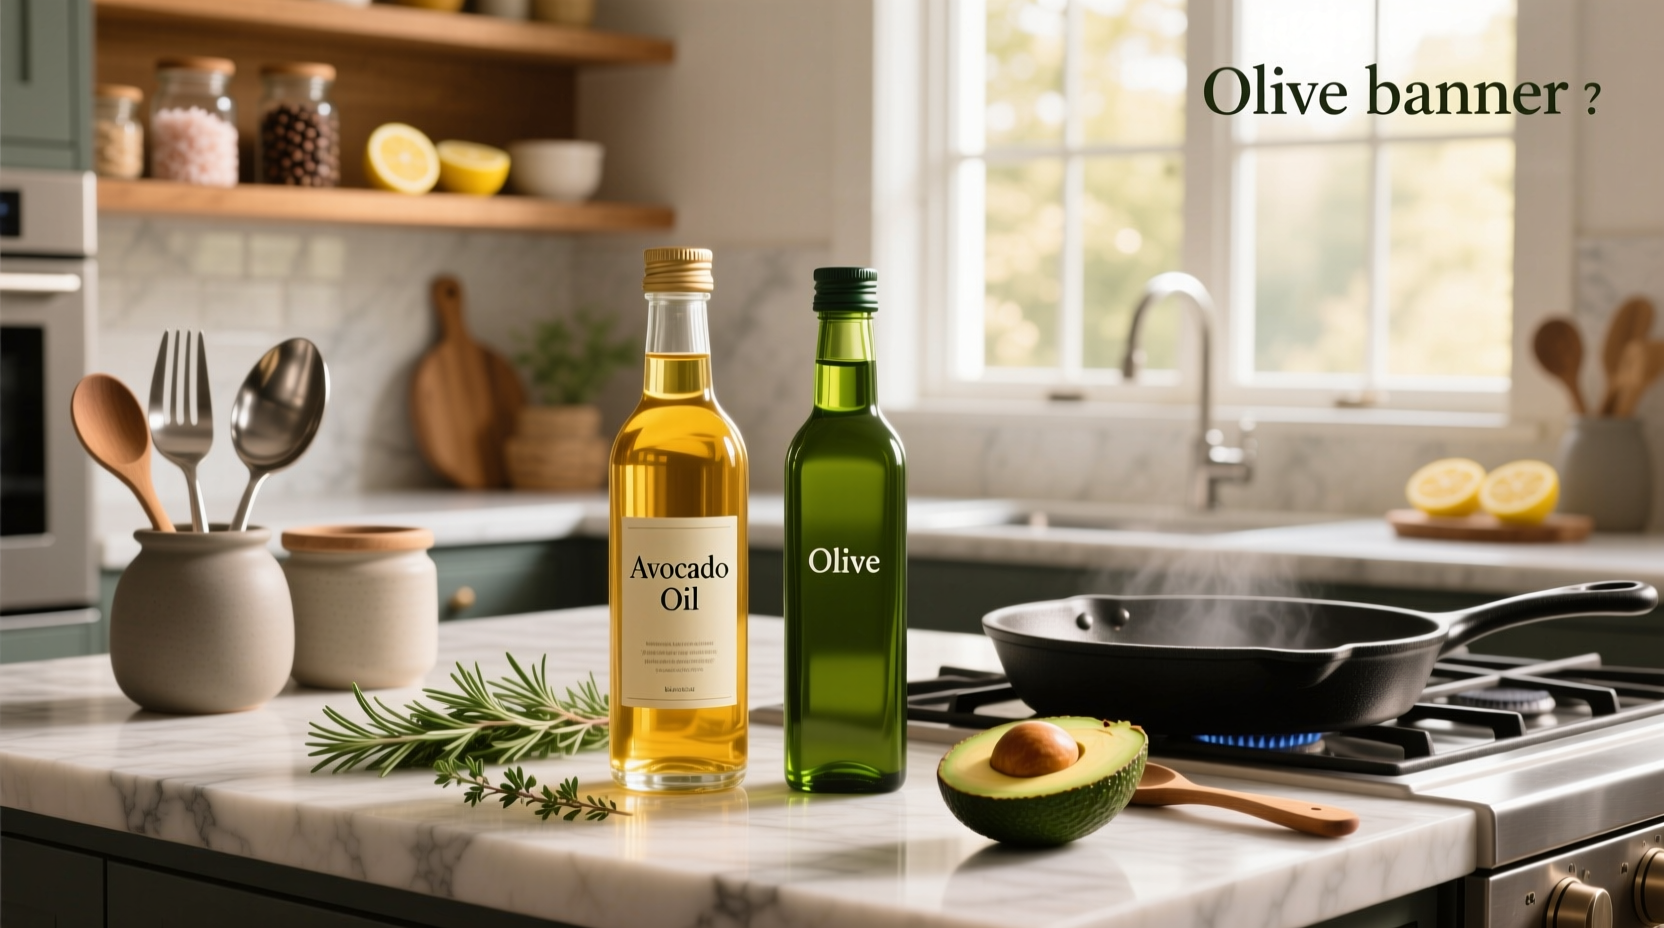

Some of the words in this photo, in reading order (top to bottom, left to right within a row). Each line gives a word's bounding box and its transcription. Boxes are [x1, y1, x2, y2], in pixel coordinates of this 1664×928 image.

[630, 555, 729, 579] Avocado
[808, 546, 881, 574] Olive
[660, 586, 699, 611] Oil
